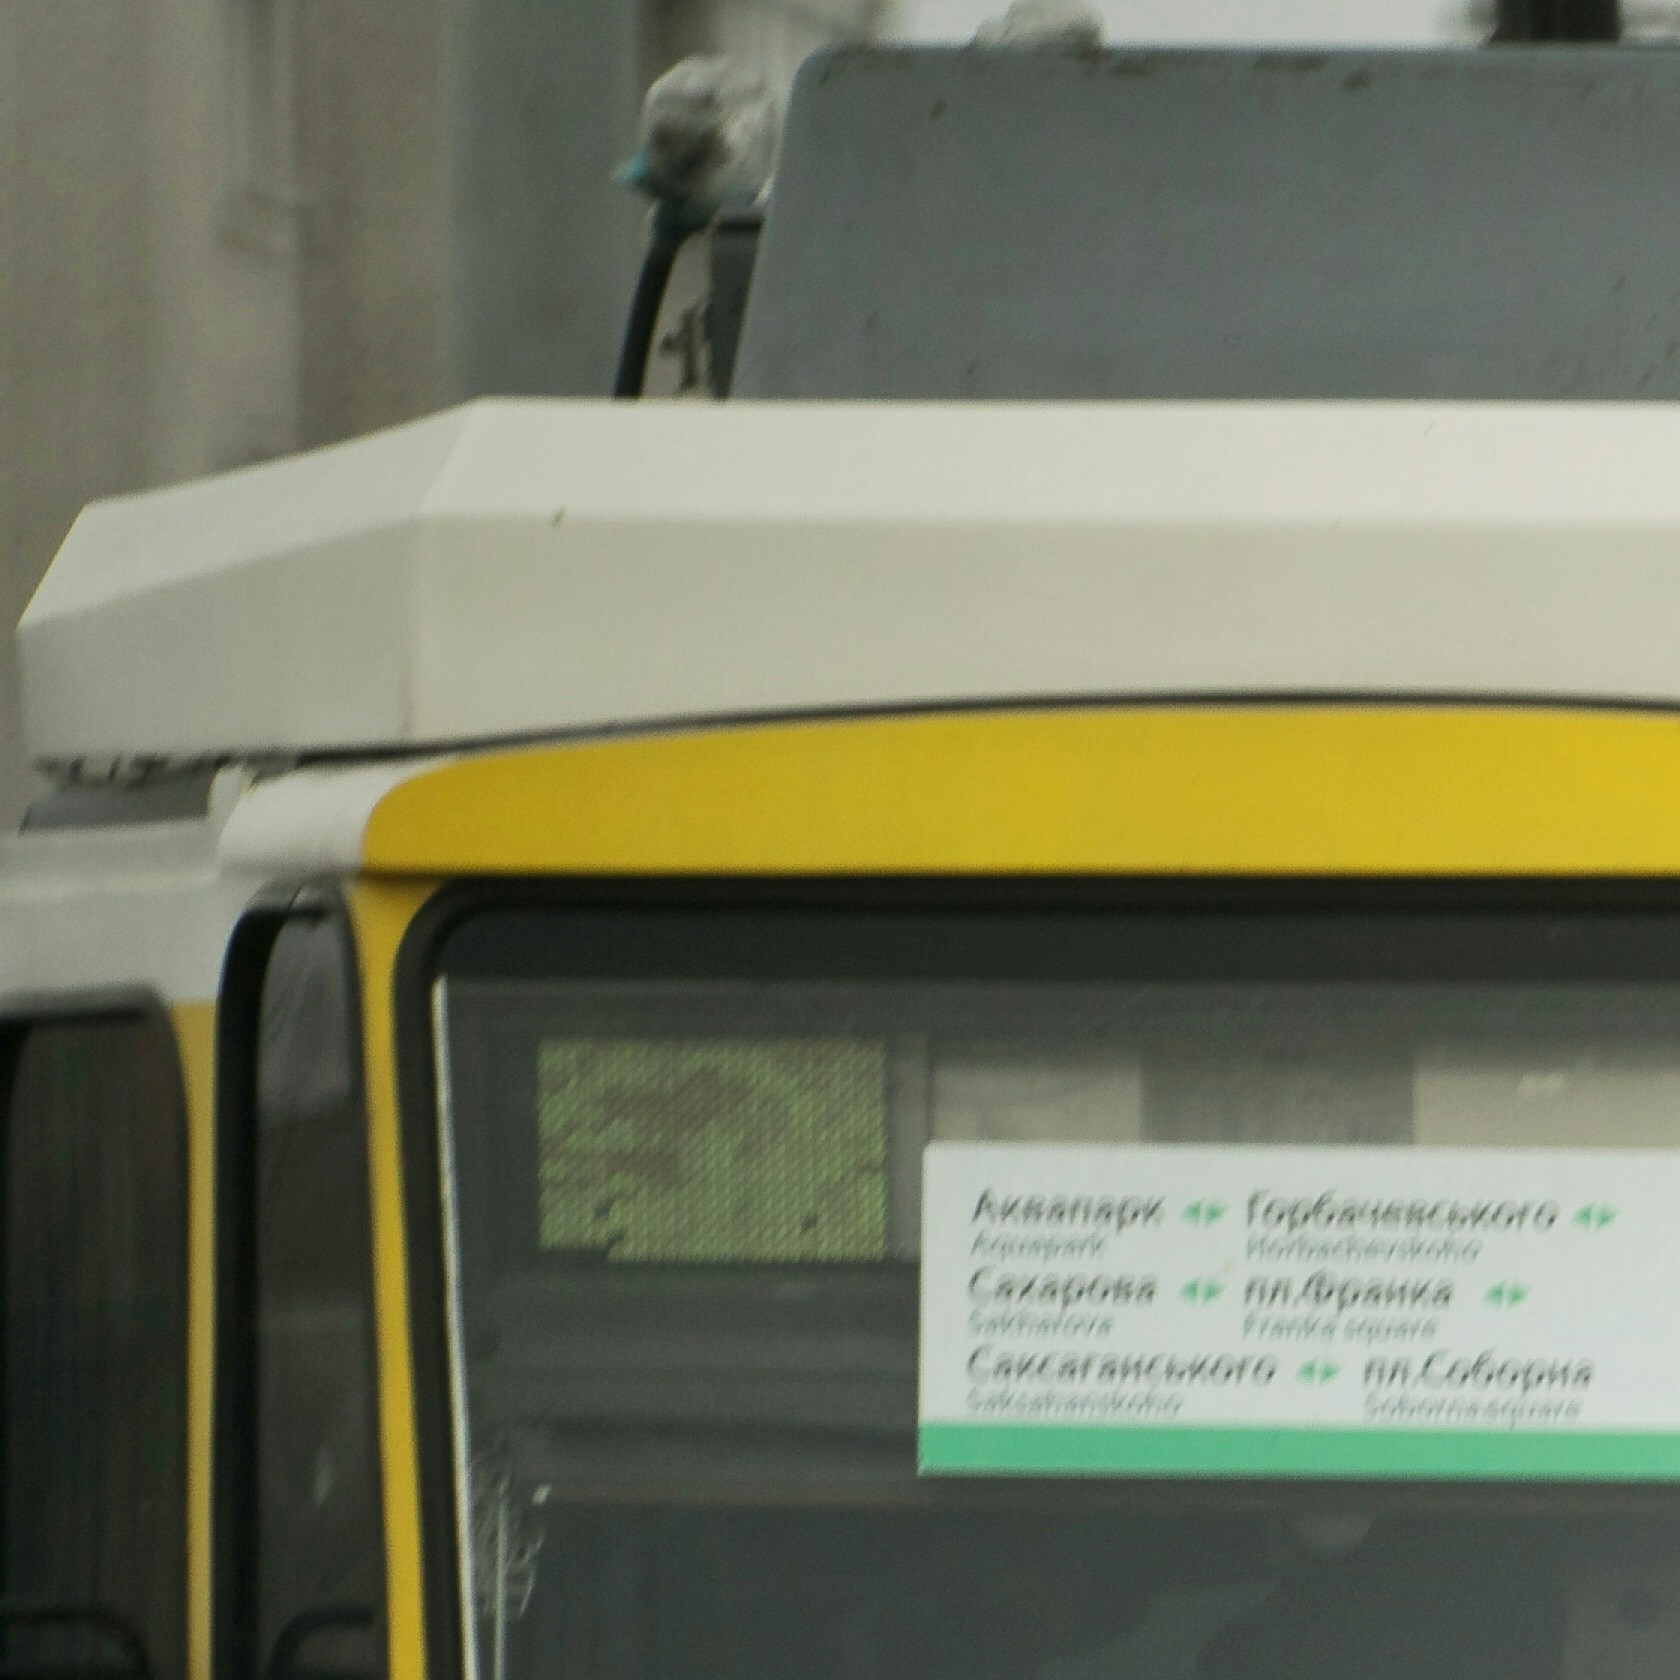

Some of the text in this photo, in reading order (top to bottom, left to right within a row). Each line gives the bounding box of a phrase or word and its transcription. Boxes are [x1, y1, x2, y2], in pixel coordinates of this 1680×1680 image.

[971, 1188, 1559, 1232] Аквапарк Горбачевського
[967, 1265, 1156, 1309] Сахарова
[967, 1345, 1280, 1384] Саксаганського
